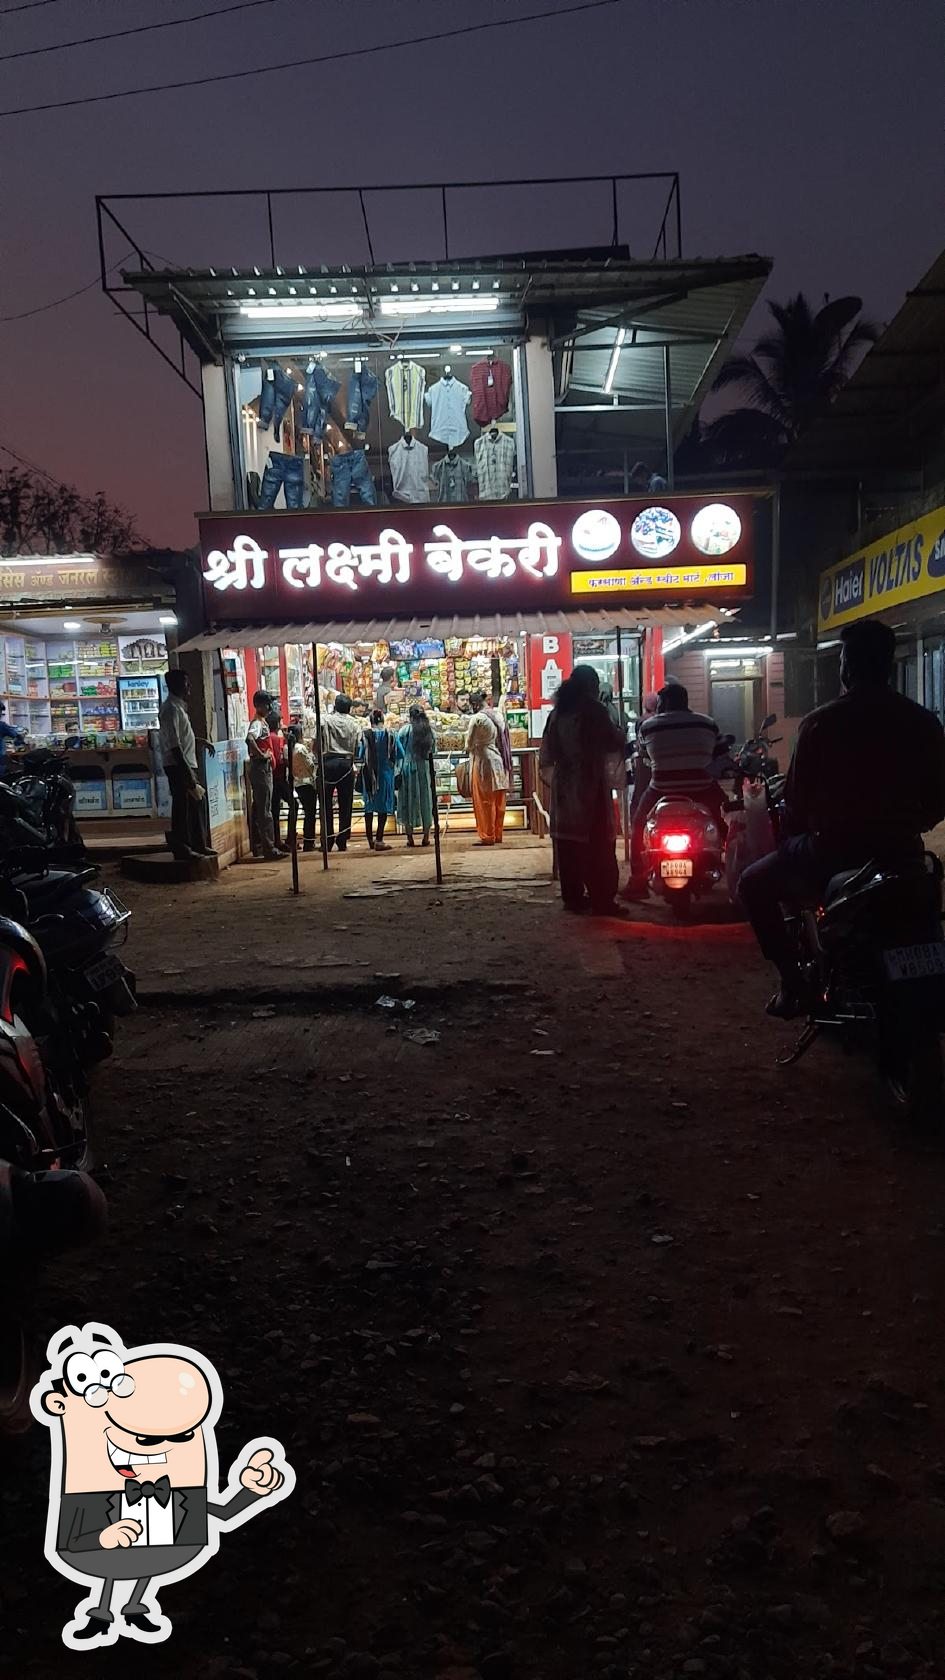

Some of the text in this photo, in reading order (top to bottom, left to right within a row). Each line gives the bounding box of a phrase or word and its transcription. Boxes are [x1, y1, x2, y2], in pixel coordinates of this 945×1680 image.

[57, 568, 99, 585] जनरल
[203, 521, 562, 591] श्री लक्ष्मी बेकरी
[835, 570, 863, 605] Haier
[869, 533, 924, 598] VOLTAS
